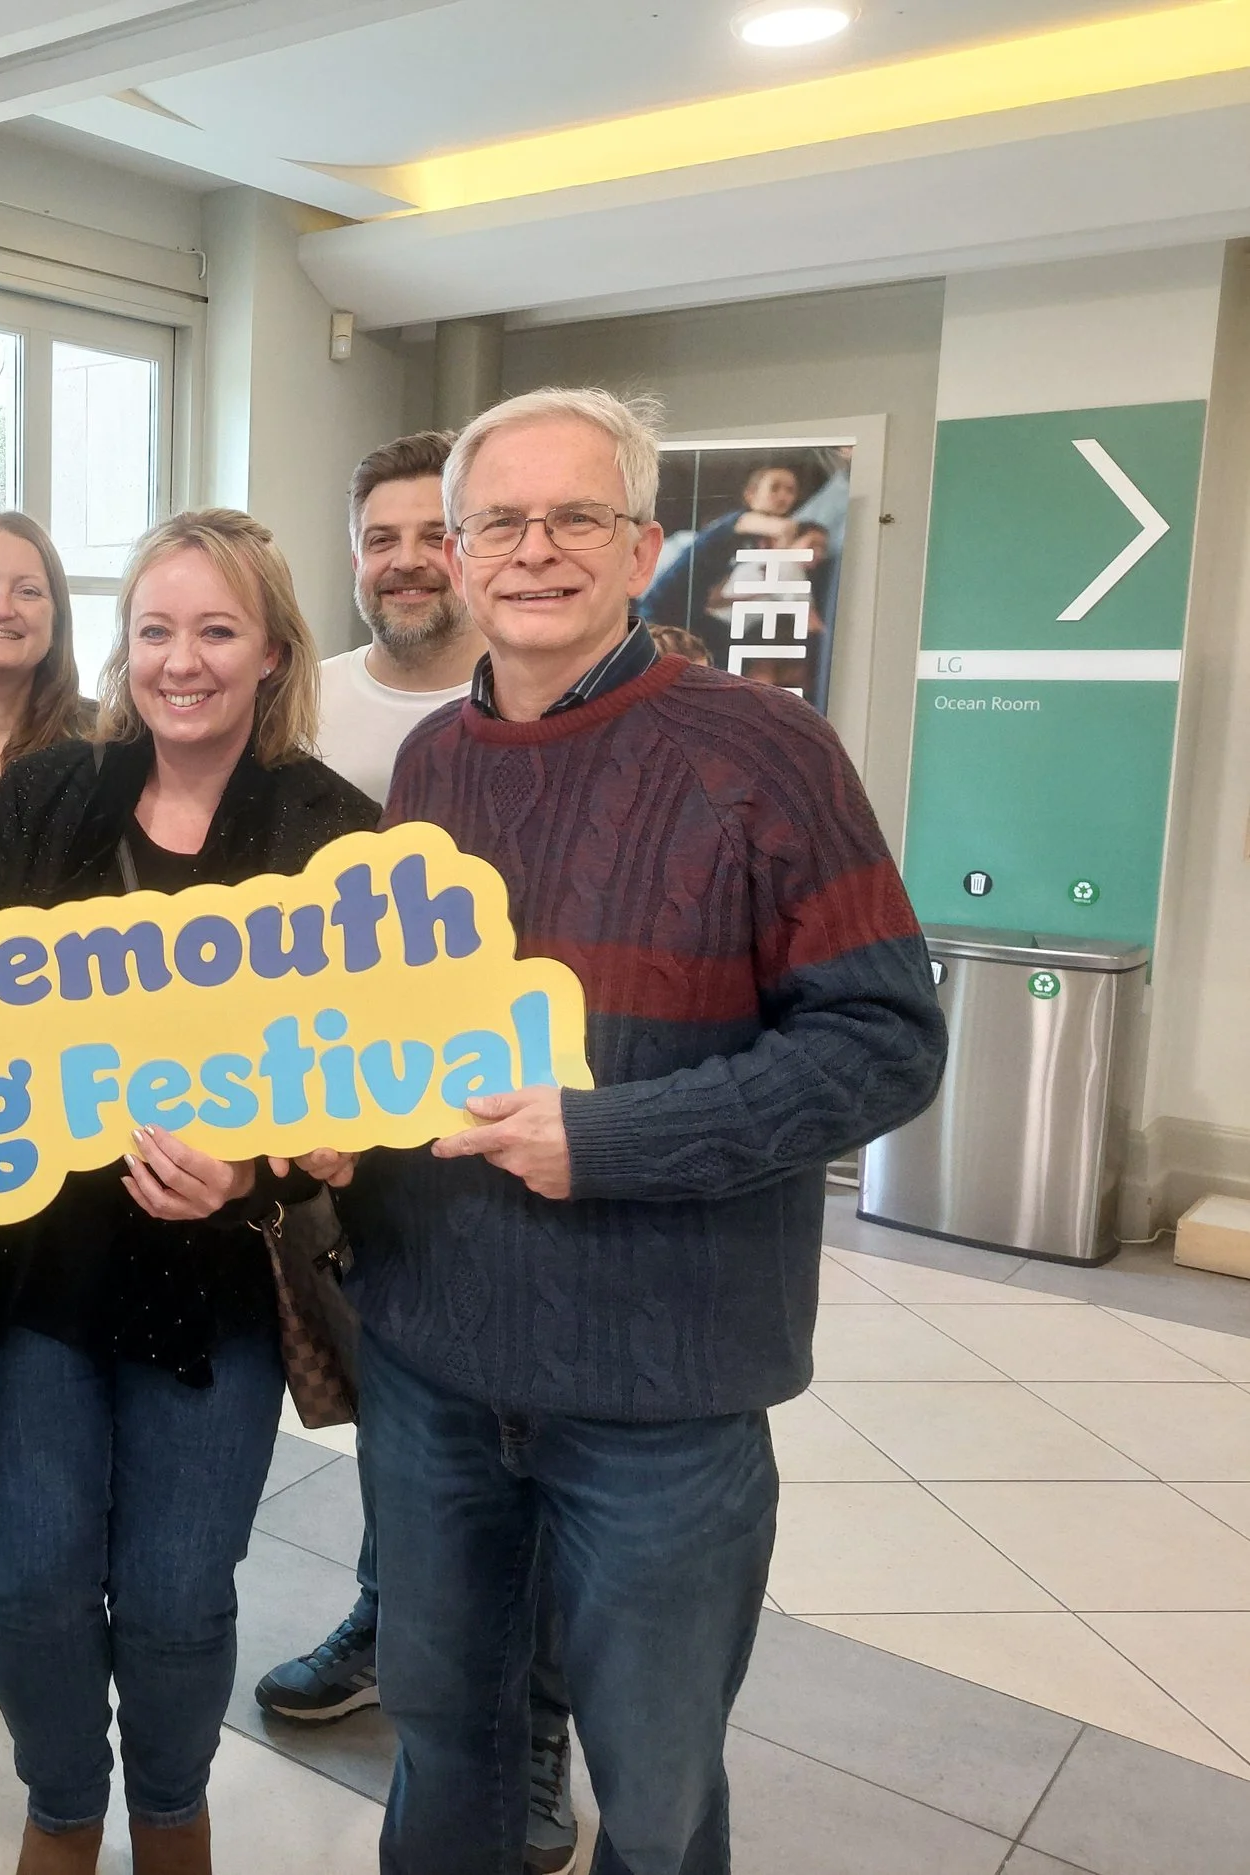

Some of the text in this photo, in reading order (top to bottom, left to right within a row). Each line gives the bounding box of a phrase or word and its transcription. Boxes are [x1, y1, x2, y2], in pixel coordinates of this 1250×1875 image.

[728, 549, 814, 698] HEL
[937, 656, 963, 673] LG
[934, 695, 1041, 711] Ocean Room
[60, 990, 557, 1140] Festival
